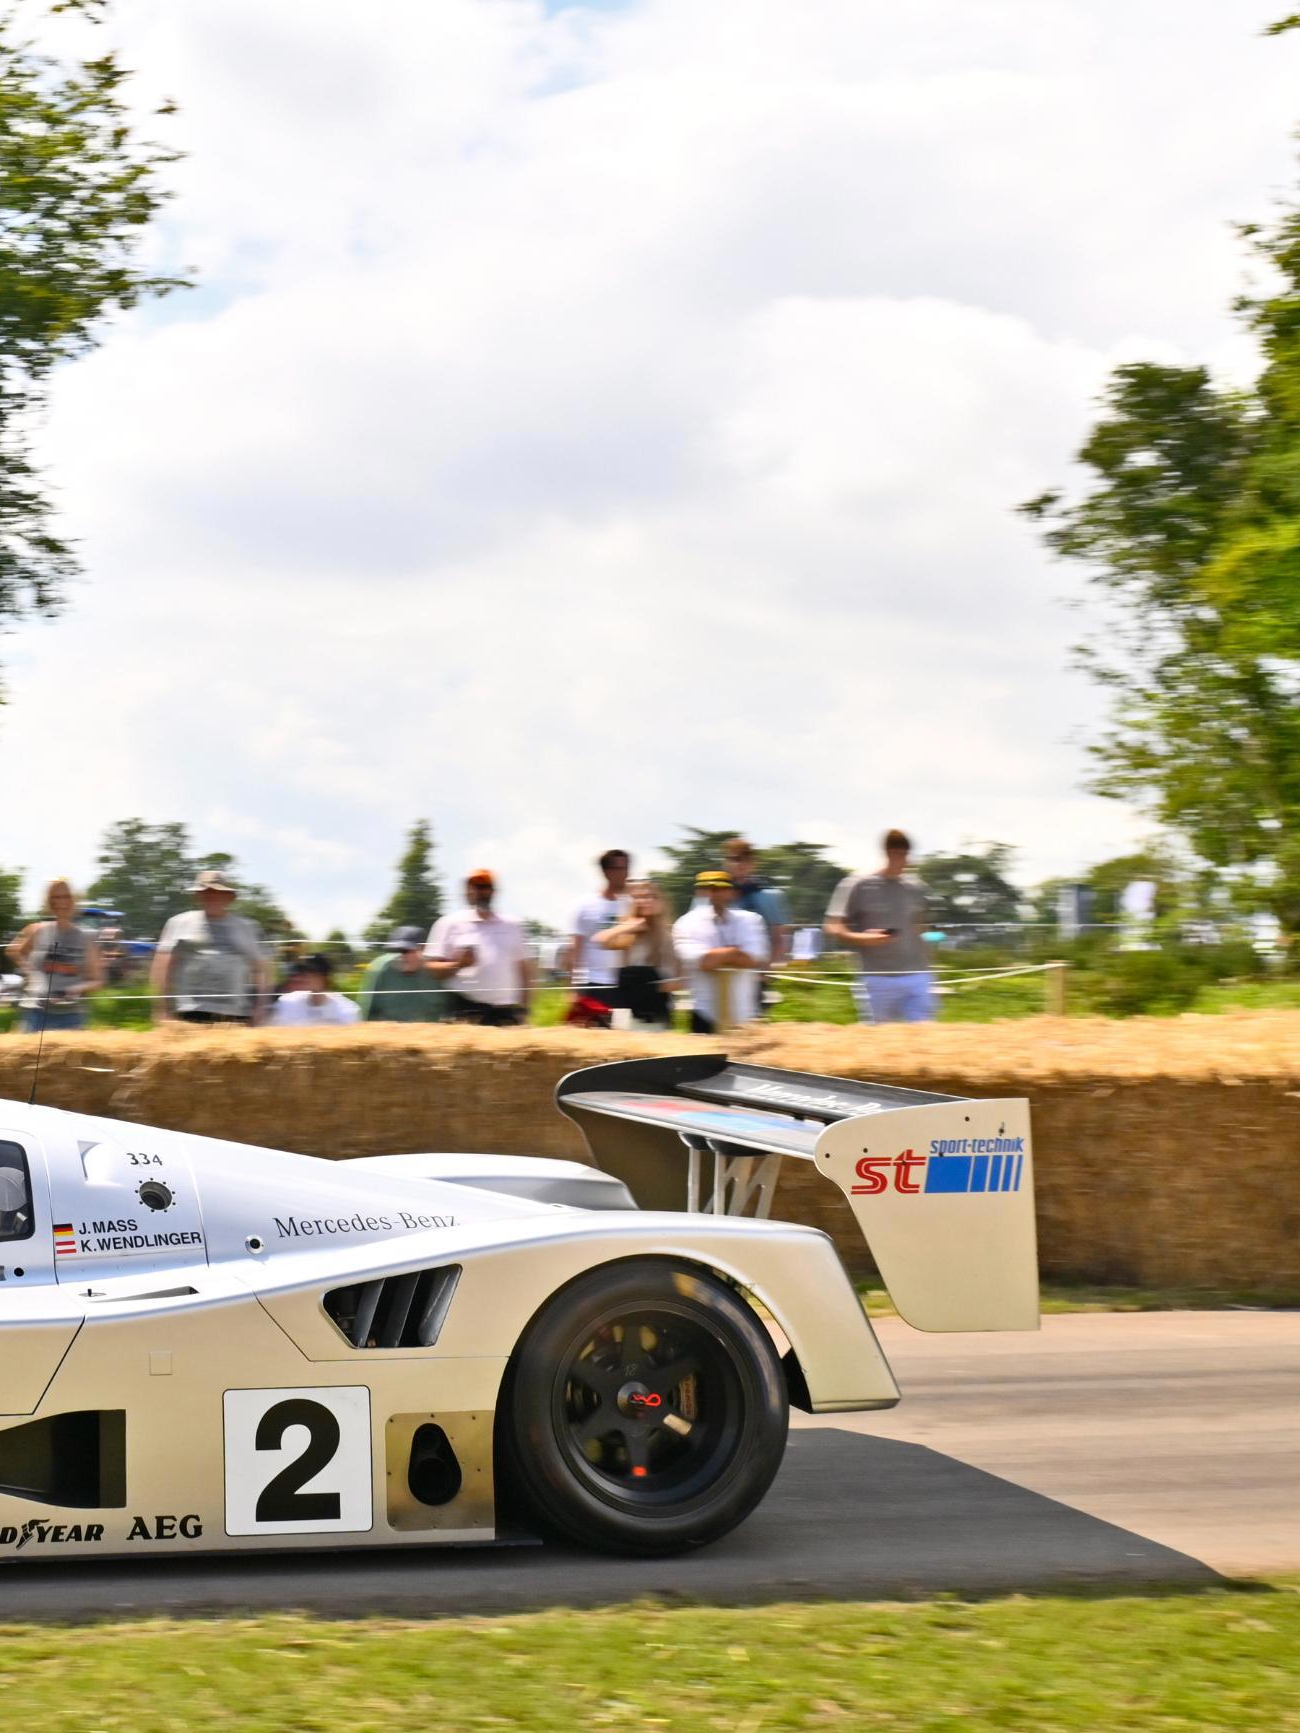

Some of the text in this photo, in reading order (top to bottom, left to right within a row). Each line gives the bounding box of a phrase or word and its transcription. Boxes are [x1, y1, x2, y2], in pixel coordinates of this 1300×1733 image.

[930, 1137, 1024, 1154] sport-technik
[126, 1152, 163, 1166] 334
[273, 1212, 456, 1238] Mercedes-Benz
[255, 1398, 341, 1523] 2
[125, 1514, 203, 1541] AEG
